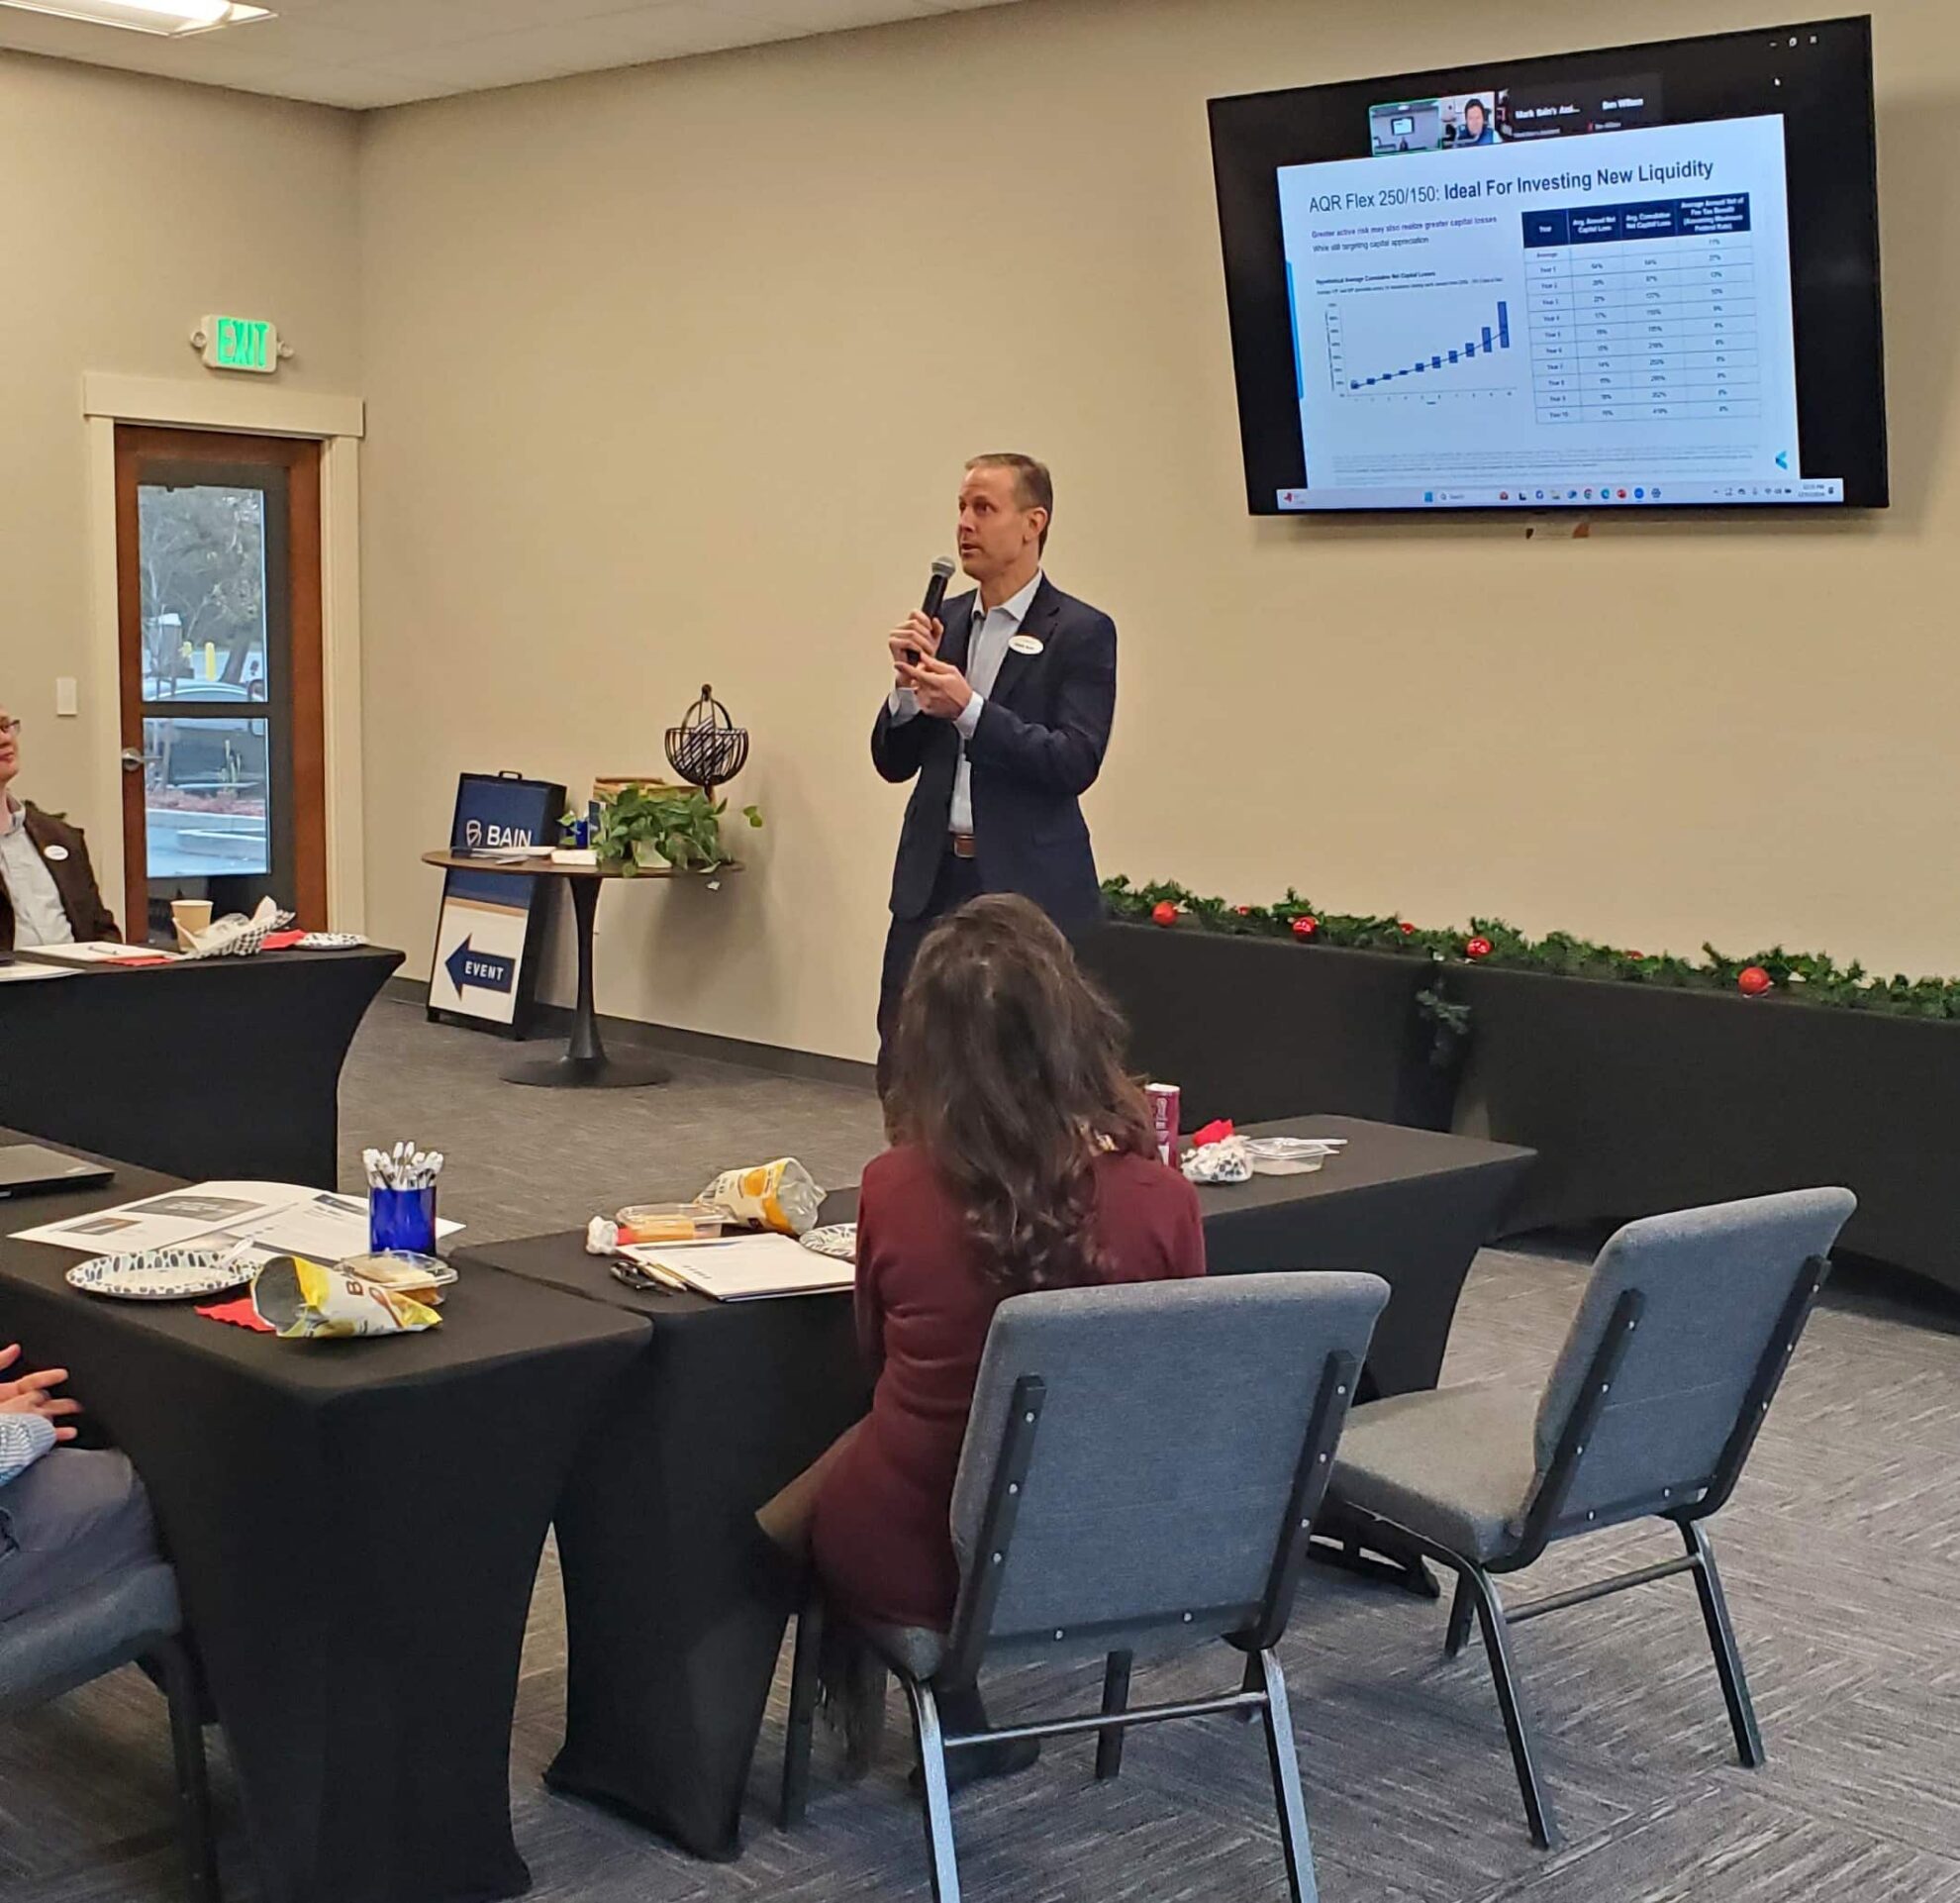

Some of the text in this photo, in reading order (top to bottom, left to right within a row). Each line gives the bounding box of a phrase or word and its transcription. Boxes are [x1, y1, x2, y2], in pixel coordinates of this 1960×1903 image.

[1310, 160, 1714, 213] AQR Flex 250/150: Ideal For Investing New Liquidity
[1424, 220, 1448, 230] greater
[1450, 218, 1473, 228] capital
[218, 317, 269, 368] EXIT
[487, 825, 532, 848] BAIN
[465, 960, 504, 981] EVENT
